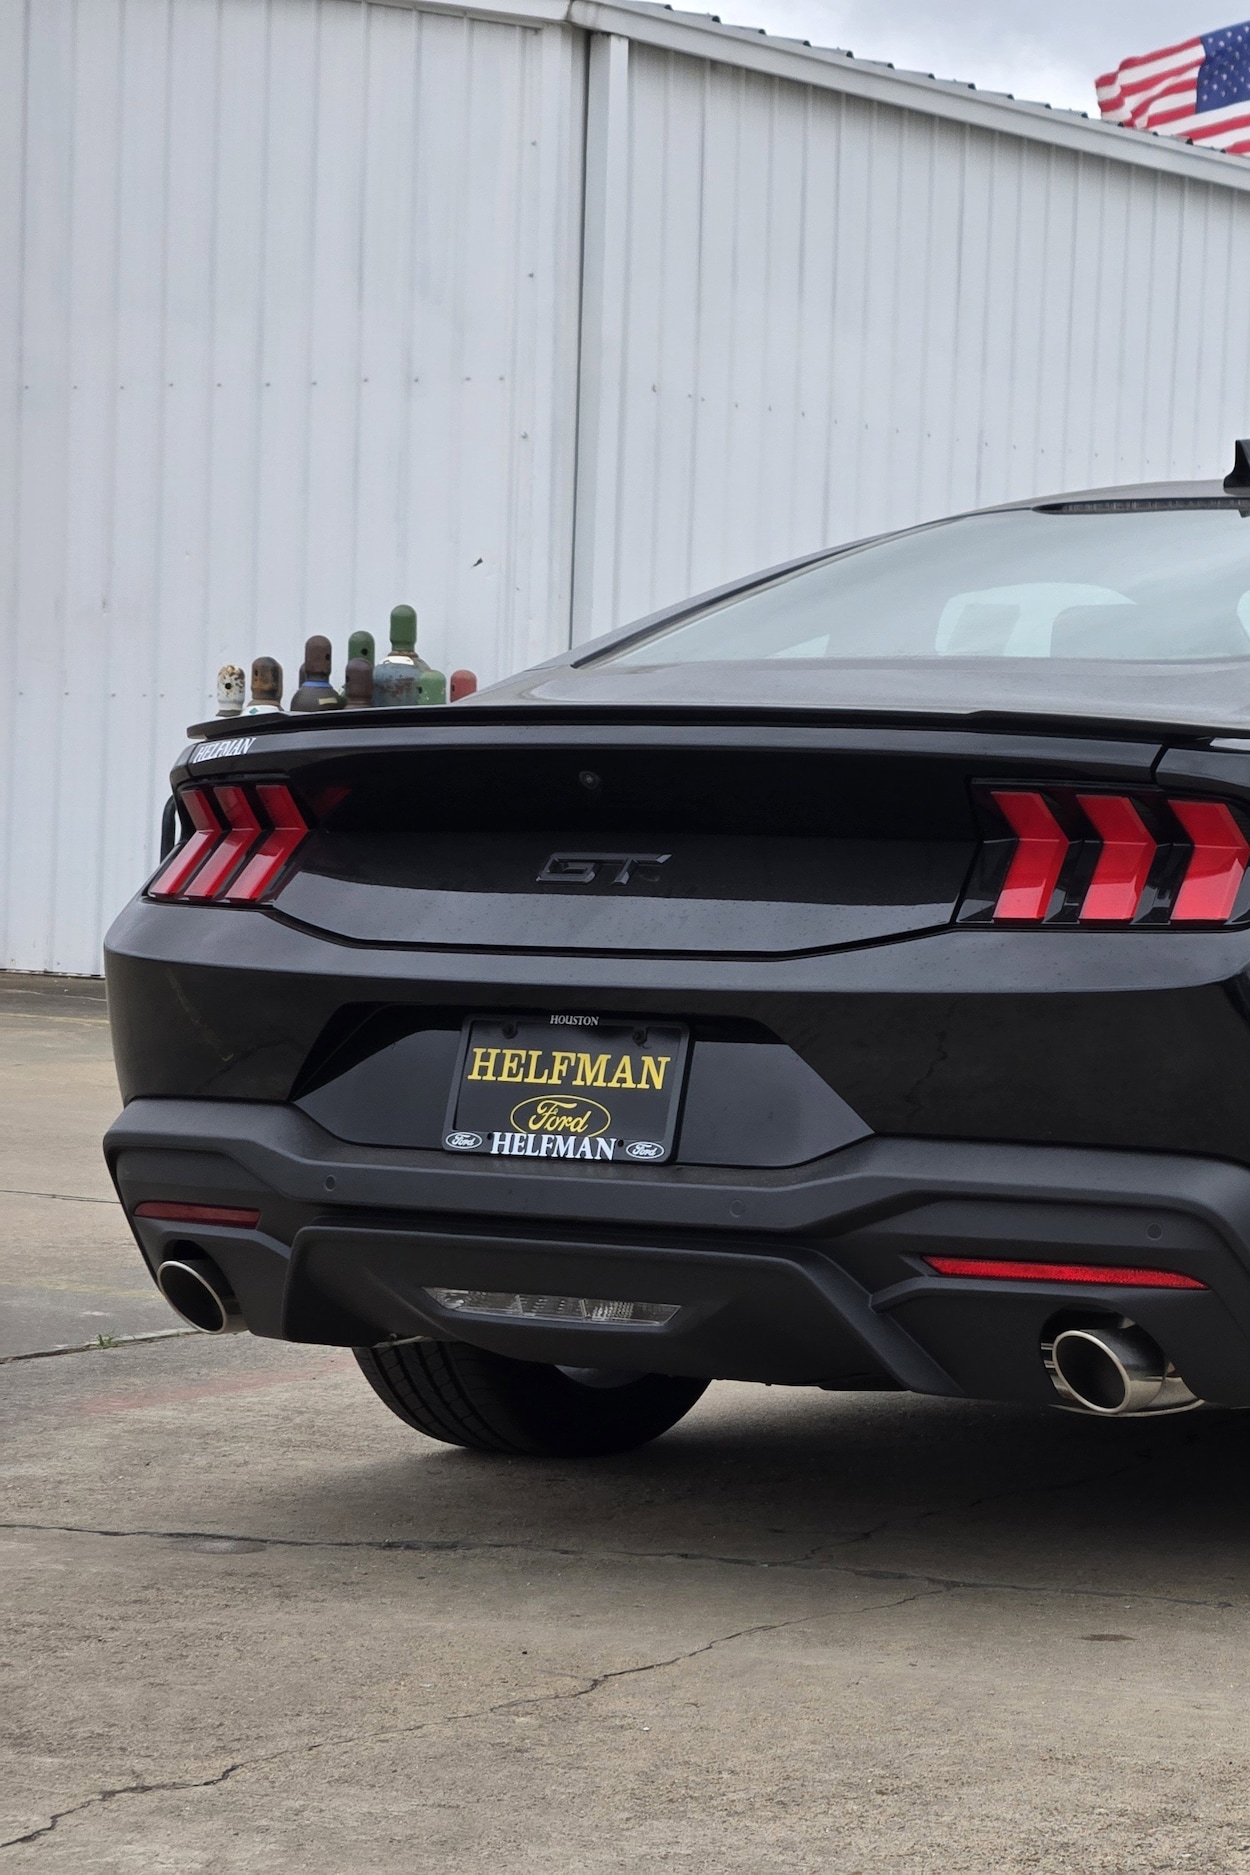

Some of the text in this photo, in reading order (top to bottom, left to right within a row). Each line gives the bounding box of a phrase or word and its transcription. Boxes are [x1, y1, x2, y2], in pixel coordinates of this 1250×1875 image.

[192, 737, 257, 764] HELFMAN
[536, 851, 673, 886] GT
[550, 1014, 600, 1026] HOUSTON
[467, 1047, 671, 1090] HELFMAN
[528, 1099, 593, 1134] Ford
[450, 1134, 476, 1148] Ford
[489, 1131, 618, 1161] HELFMAN
[632, 1142, 659, 1157] Ford
